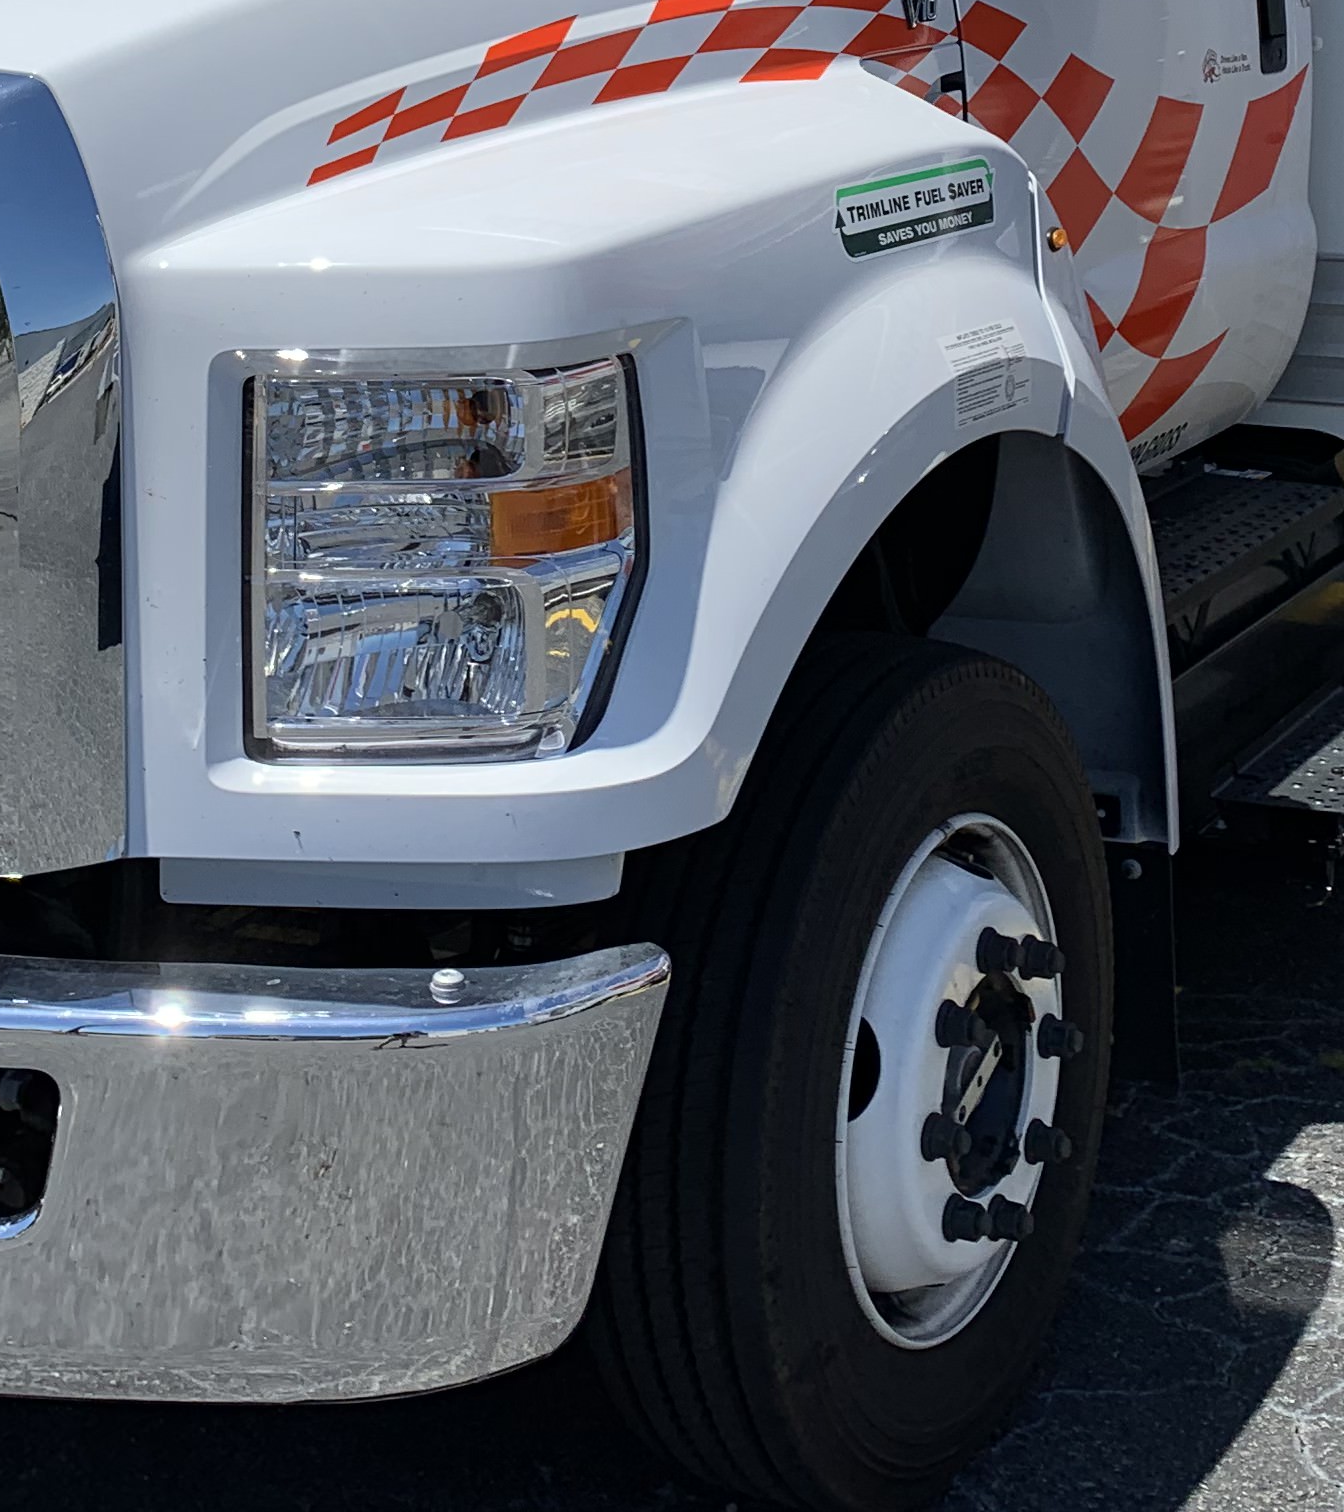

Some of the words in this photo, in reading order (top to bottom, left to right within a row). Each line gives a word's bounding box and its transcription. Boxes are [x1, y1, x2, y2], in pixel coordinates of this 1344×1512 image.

[846, 194, 911, 224] TRIMLINE
[914, 187, 946, 208] FUEL
[947, 178, 985, 201] SAVER
[877, 226, 914, 246] SAVES
[914, 220, 938, 236] YOU
[939, 211, 974, 231] MONEY
